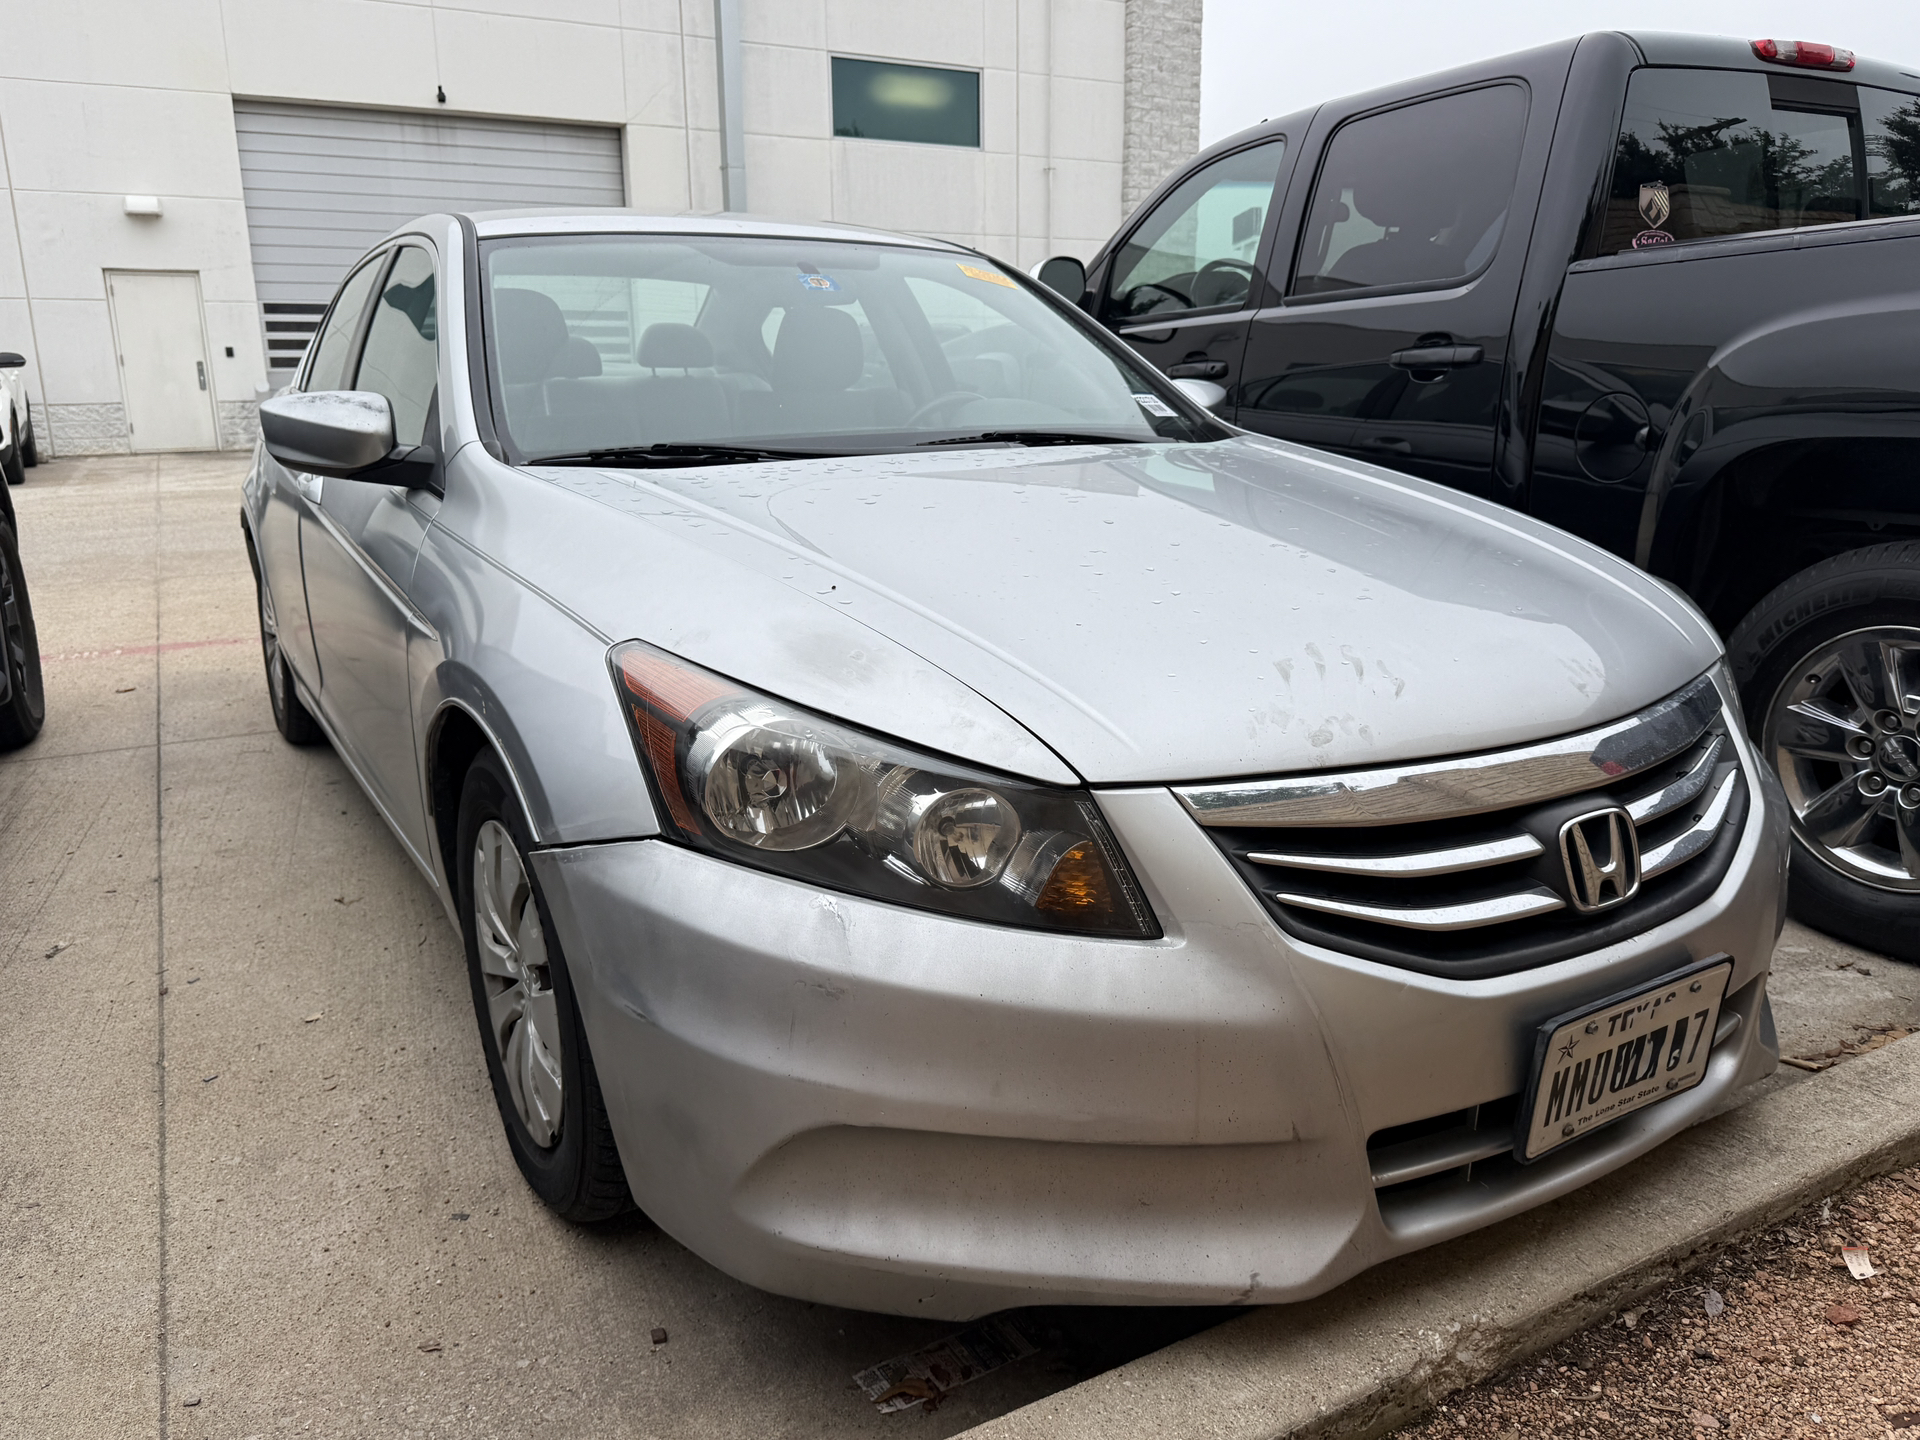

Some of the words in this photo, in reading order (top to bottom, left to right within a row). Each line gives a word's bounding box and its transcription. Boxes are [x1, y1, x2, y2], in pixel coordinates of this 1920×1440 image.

[1577, 1114, 1593, 1126] The
[1595, 1103, 1616, 1117] Lone
[1617, 1094, 1636, 1108] Star
[1637, 1085, 1660, 1099] State
